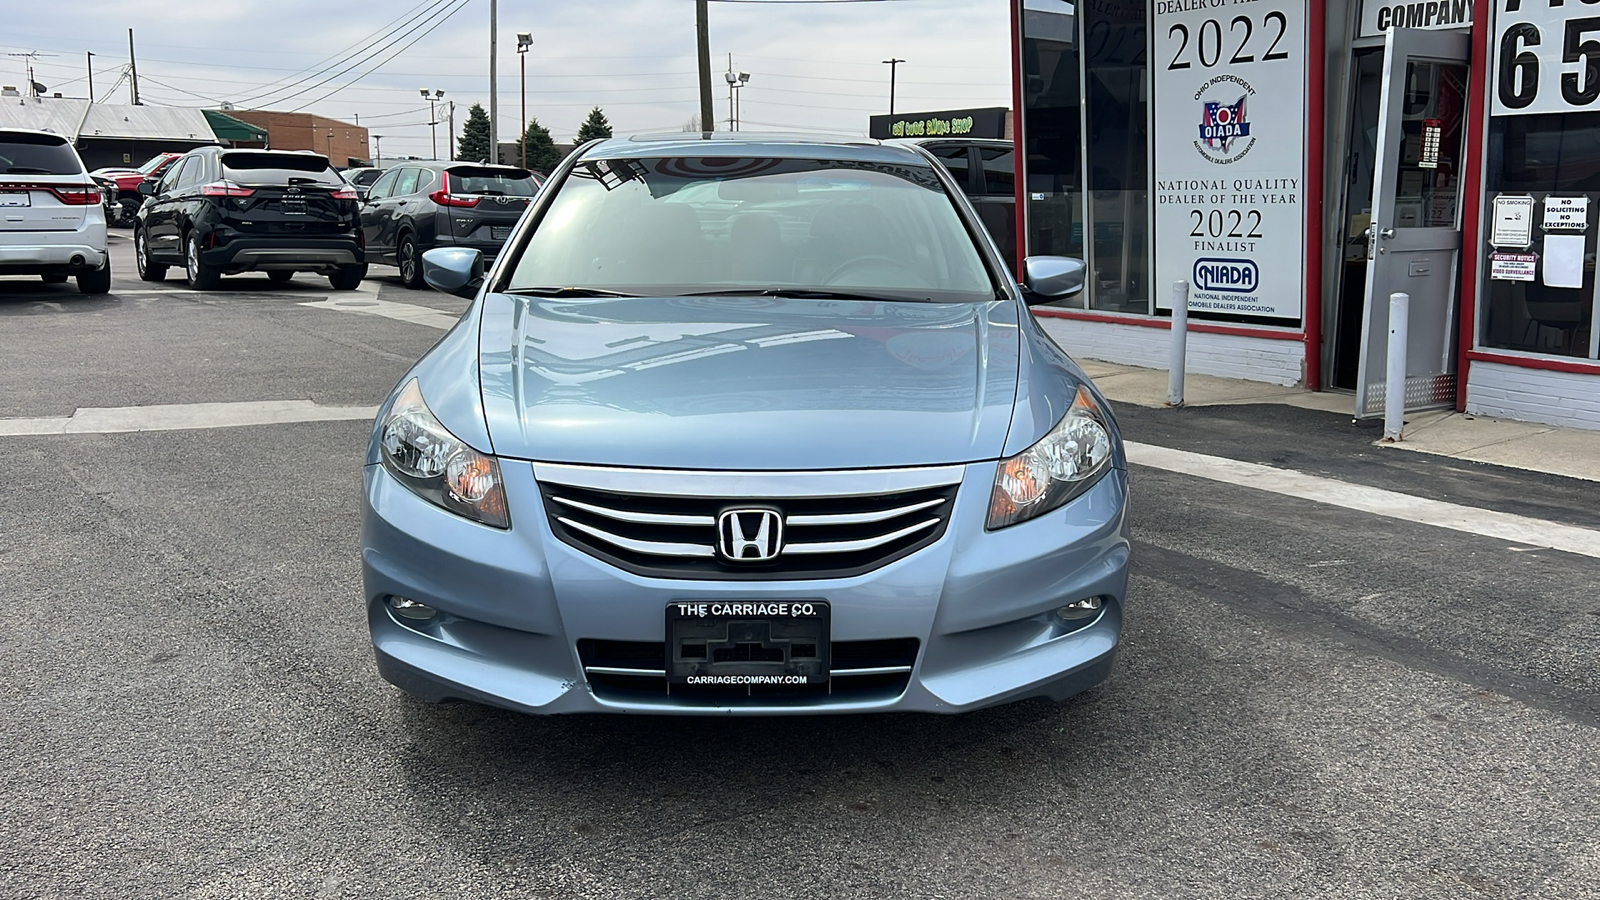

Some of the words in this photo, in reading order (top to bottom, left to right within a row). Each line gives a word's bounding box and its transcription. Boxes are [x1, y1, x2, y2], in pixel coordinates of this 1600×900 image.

[1157, 0, 1207, 14] DEALER
[1167, 10, 1289, 71] 2022
[1194, 82, 1210, 101] OHIO
[1210, 74, 1256, 97] INDEPENDENT
[951, 115, 973, 134] SHOP
[1204, 124, 1242, 138] OIADA
[1193, 140, 1214, 163] AUTOMOBILE
[1233, 137, 1257, 162] ASSOCIATION
[1158, 180, 1227, 191] NATIONAL
[1233, 179, 1299, 191] QUALITY
[1159, 194, 1205, 204] DEALER
[1210, 194, 1226, 204] OF
[1231, 194, 1256, 204] THE
[1262, 194, 1297, 204] YEAR
[1189, 209, 1263, 239] 2022
[1194, 241, 1256, 252] FINALIST
[1198, 265, 1253, 287] NIADA
[1194, 293, 1220, 301] NATIONAL
[1221, 294, 1259, 303] INDEPENDENT
[1188, 300, 1213, 309] OMOBILE
[1213, 302, 1236, 310] DEALERS
[1237, 304, 1275, 313] ASSOCIATION
[677, 603, 708, 617] THE
[711, 603, 788, 616] CARRIAGE
[791, 603, 817, 617] CO.
[687, 675, 808, 684] CARRIAGECOMPANY.COM
